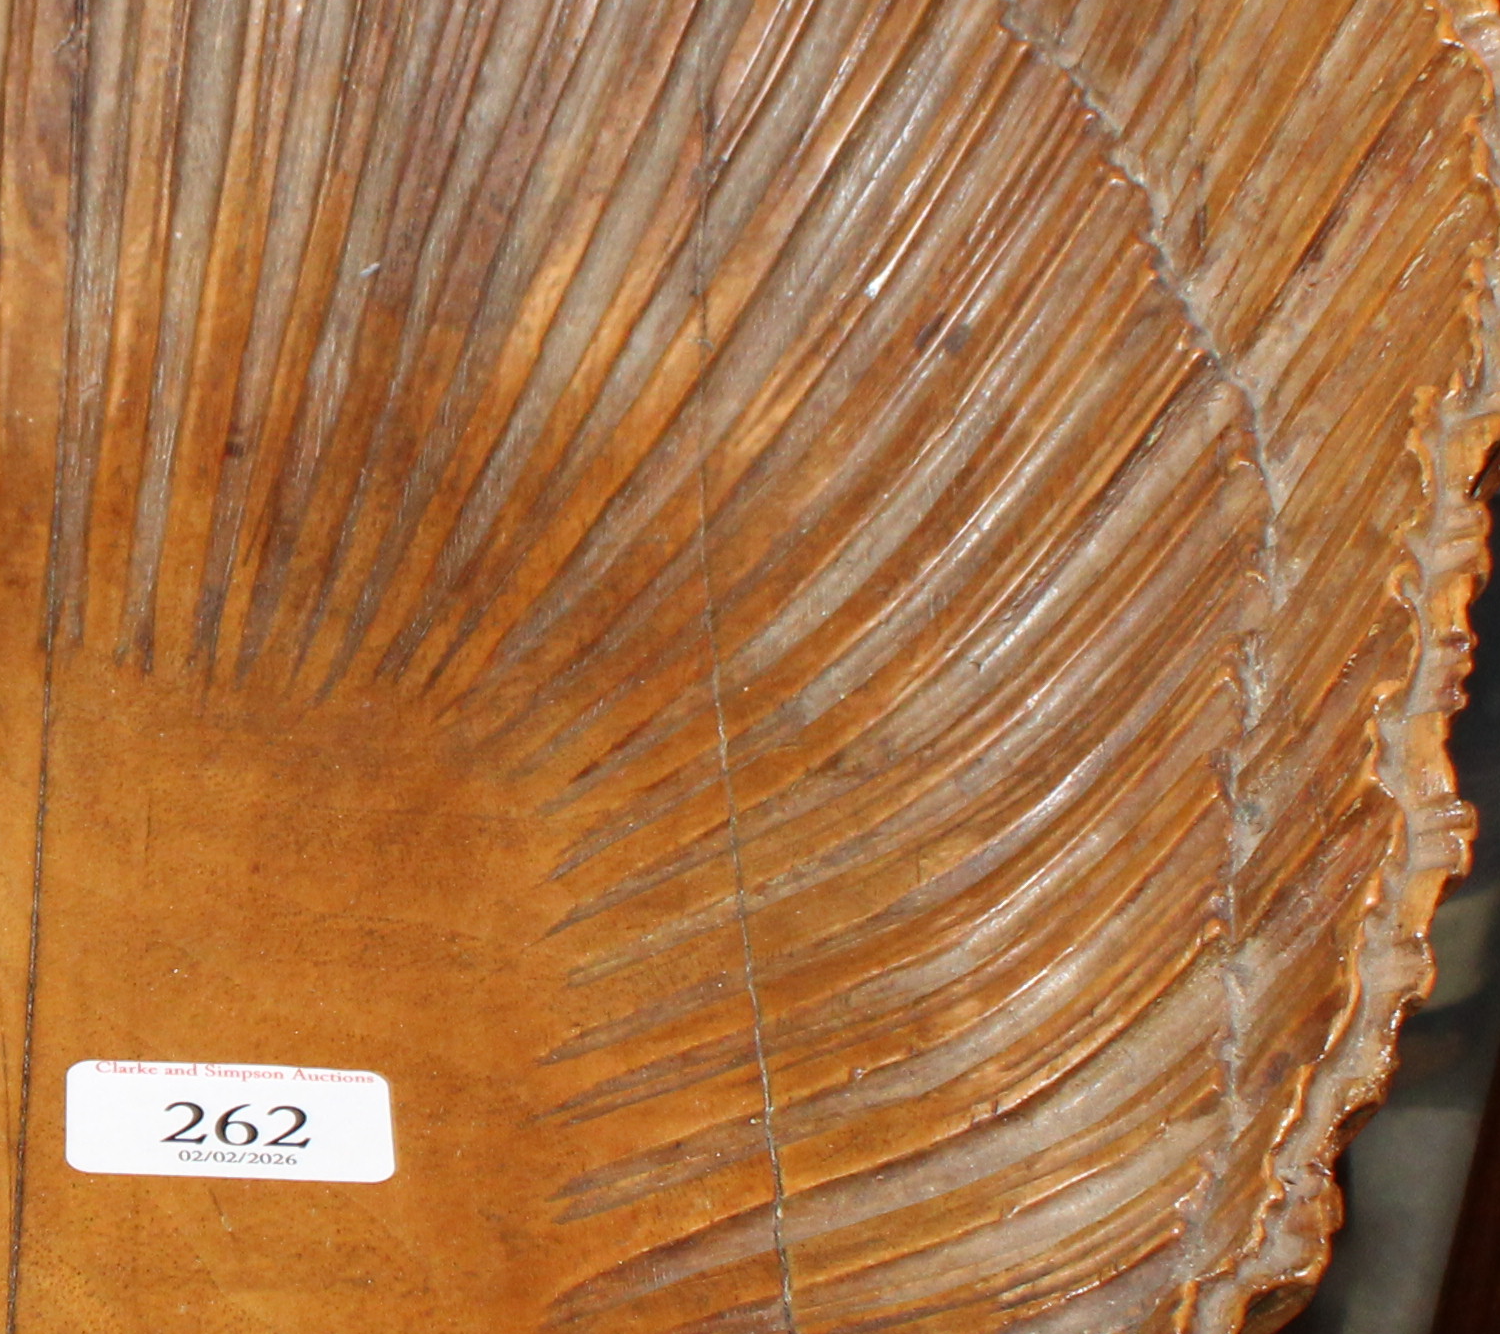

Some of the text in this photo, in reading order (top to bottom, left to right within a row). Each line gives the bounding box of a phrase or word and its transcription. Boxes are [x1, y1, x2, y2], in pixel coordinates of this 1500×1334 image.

[95, 1060, 375, 1084] Clarke and Simpson Auctions
[159, 1101, 312, 1149] 262
[177, 1149, 298, 1166] 02/02/2026
